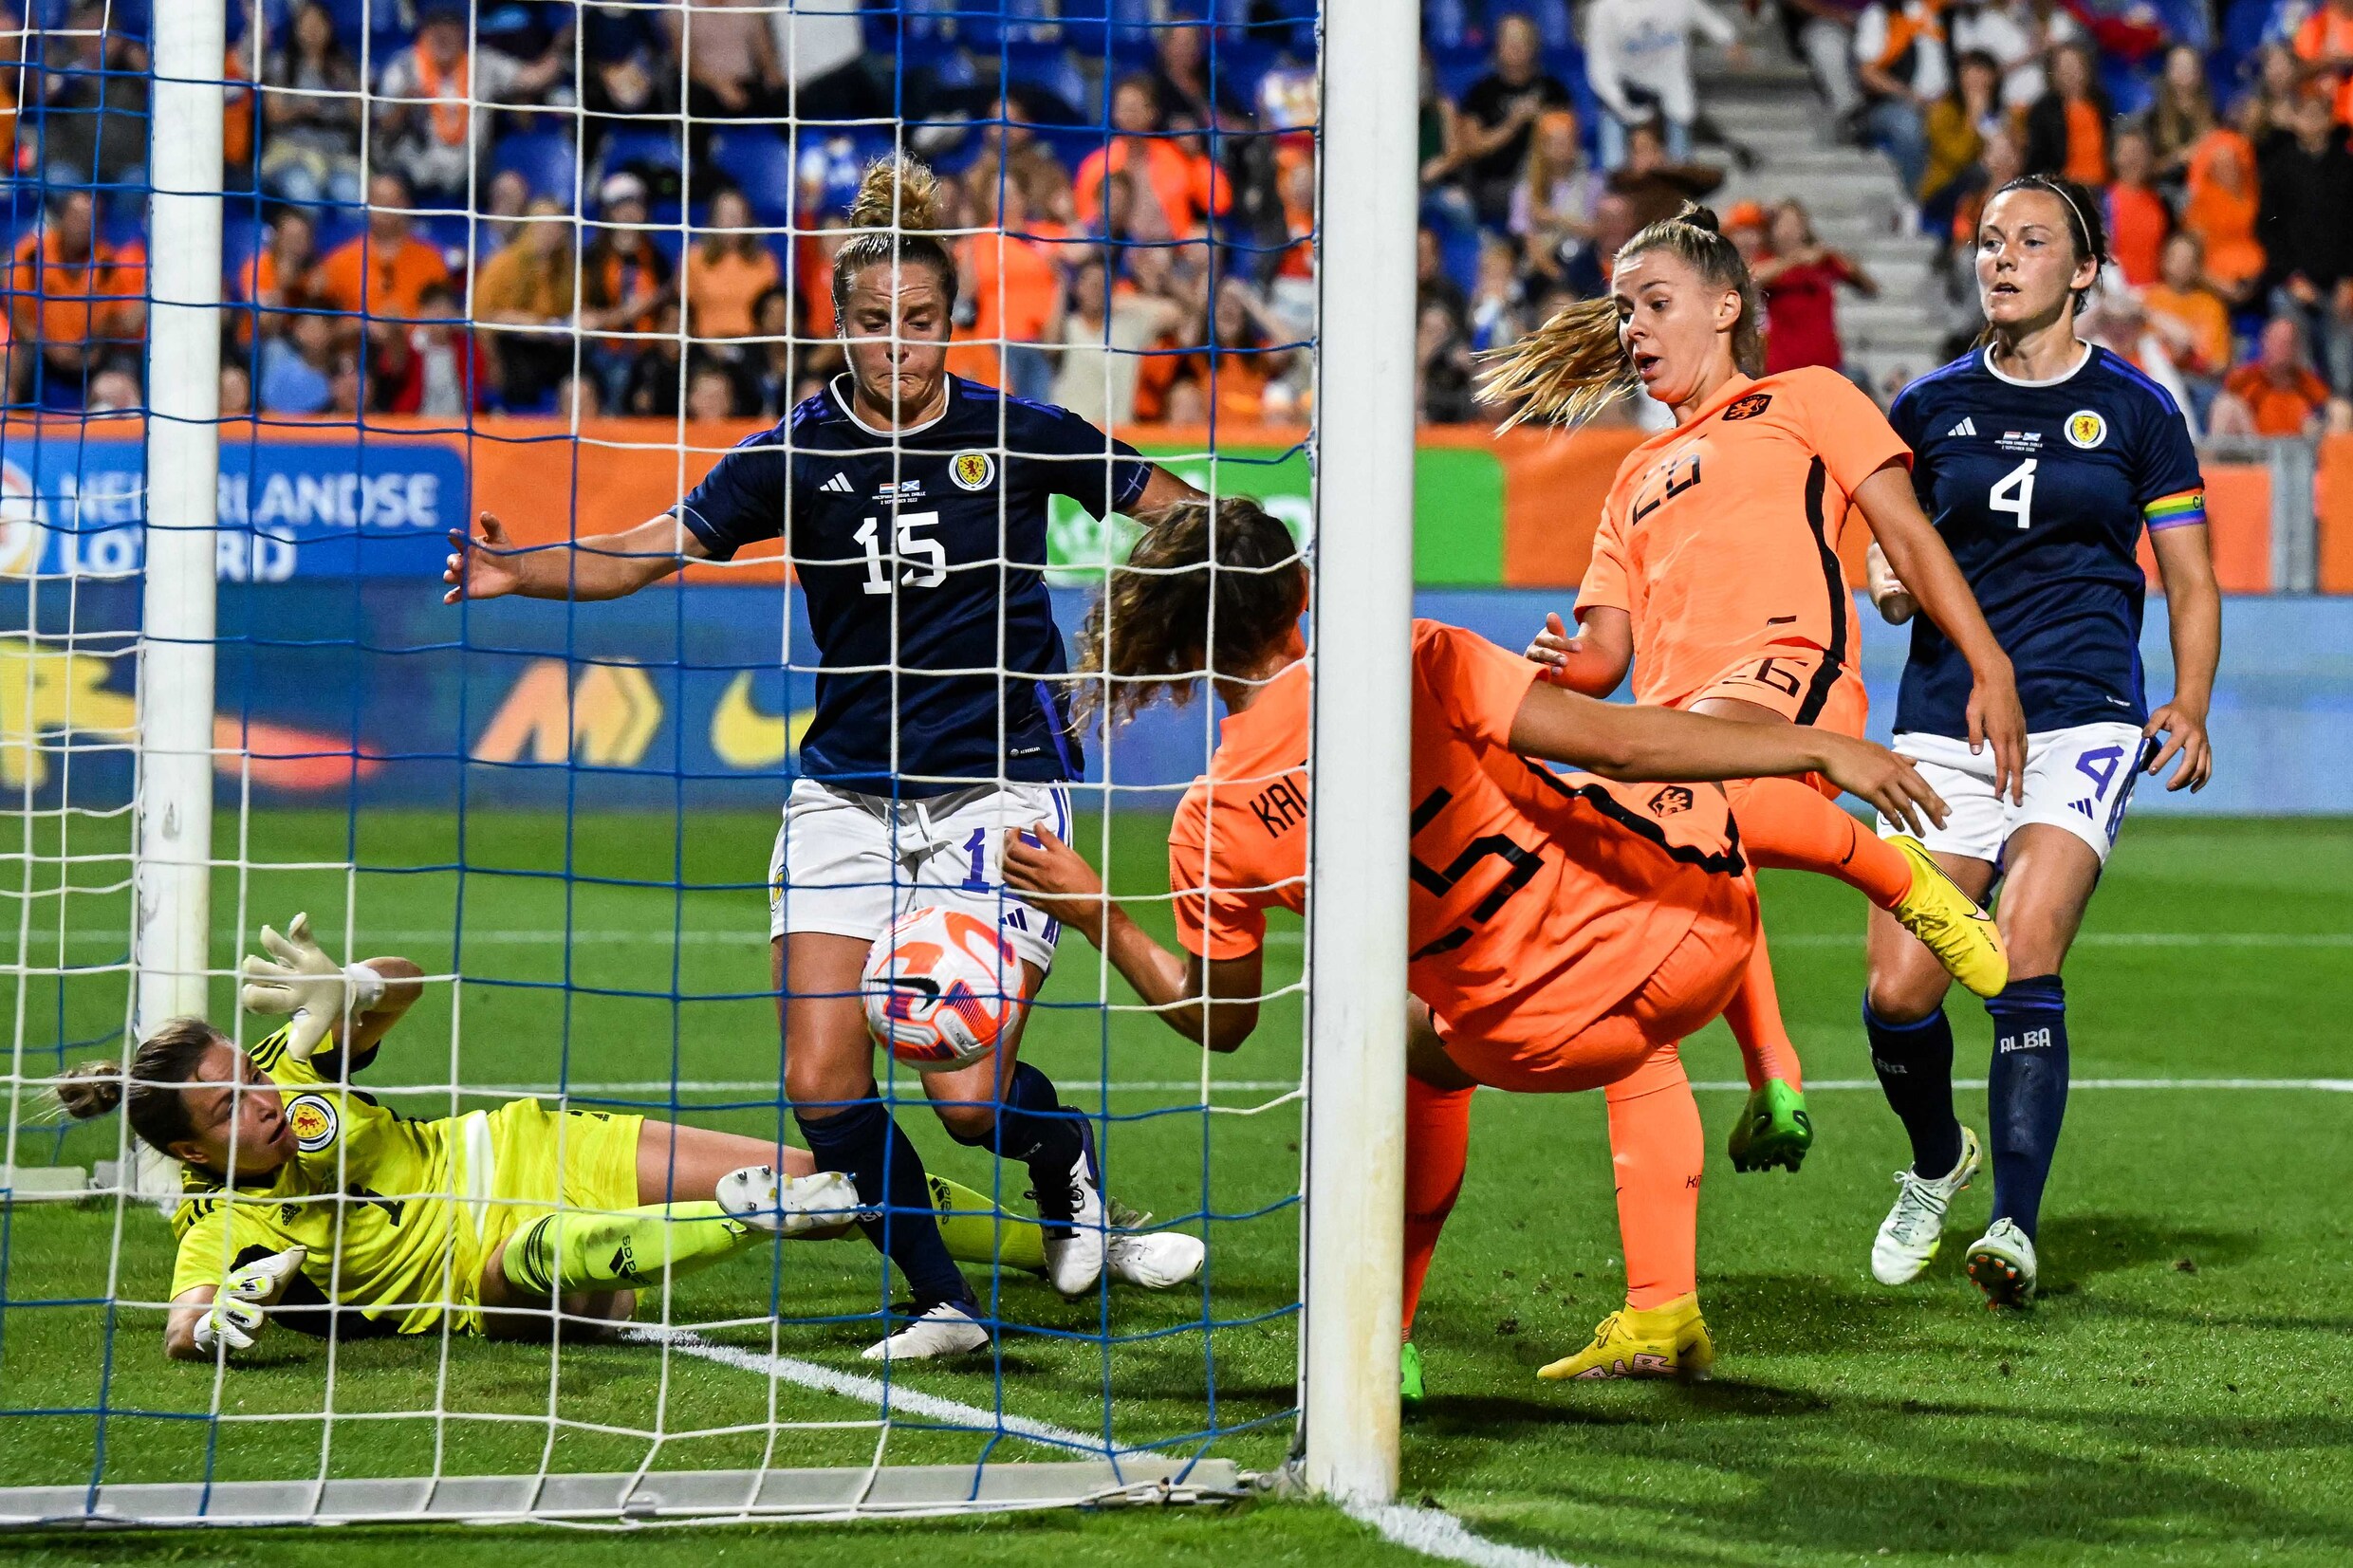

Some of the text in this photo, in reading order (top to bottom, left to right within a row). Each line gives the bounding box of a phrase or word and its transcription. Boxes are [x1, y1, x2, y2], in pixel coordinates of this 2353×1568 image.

[1989, 458, 2038, 529] 4
[852, 510, 947, 595] 15
[2075, 745, 2124, 802] 4
[2000, 1027, 2052, 1055] ALBA
